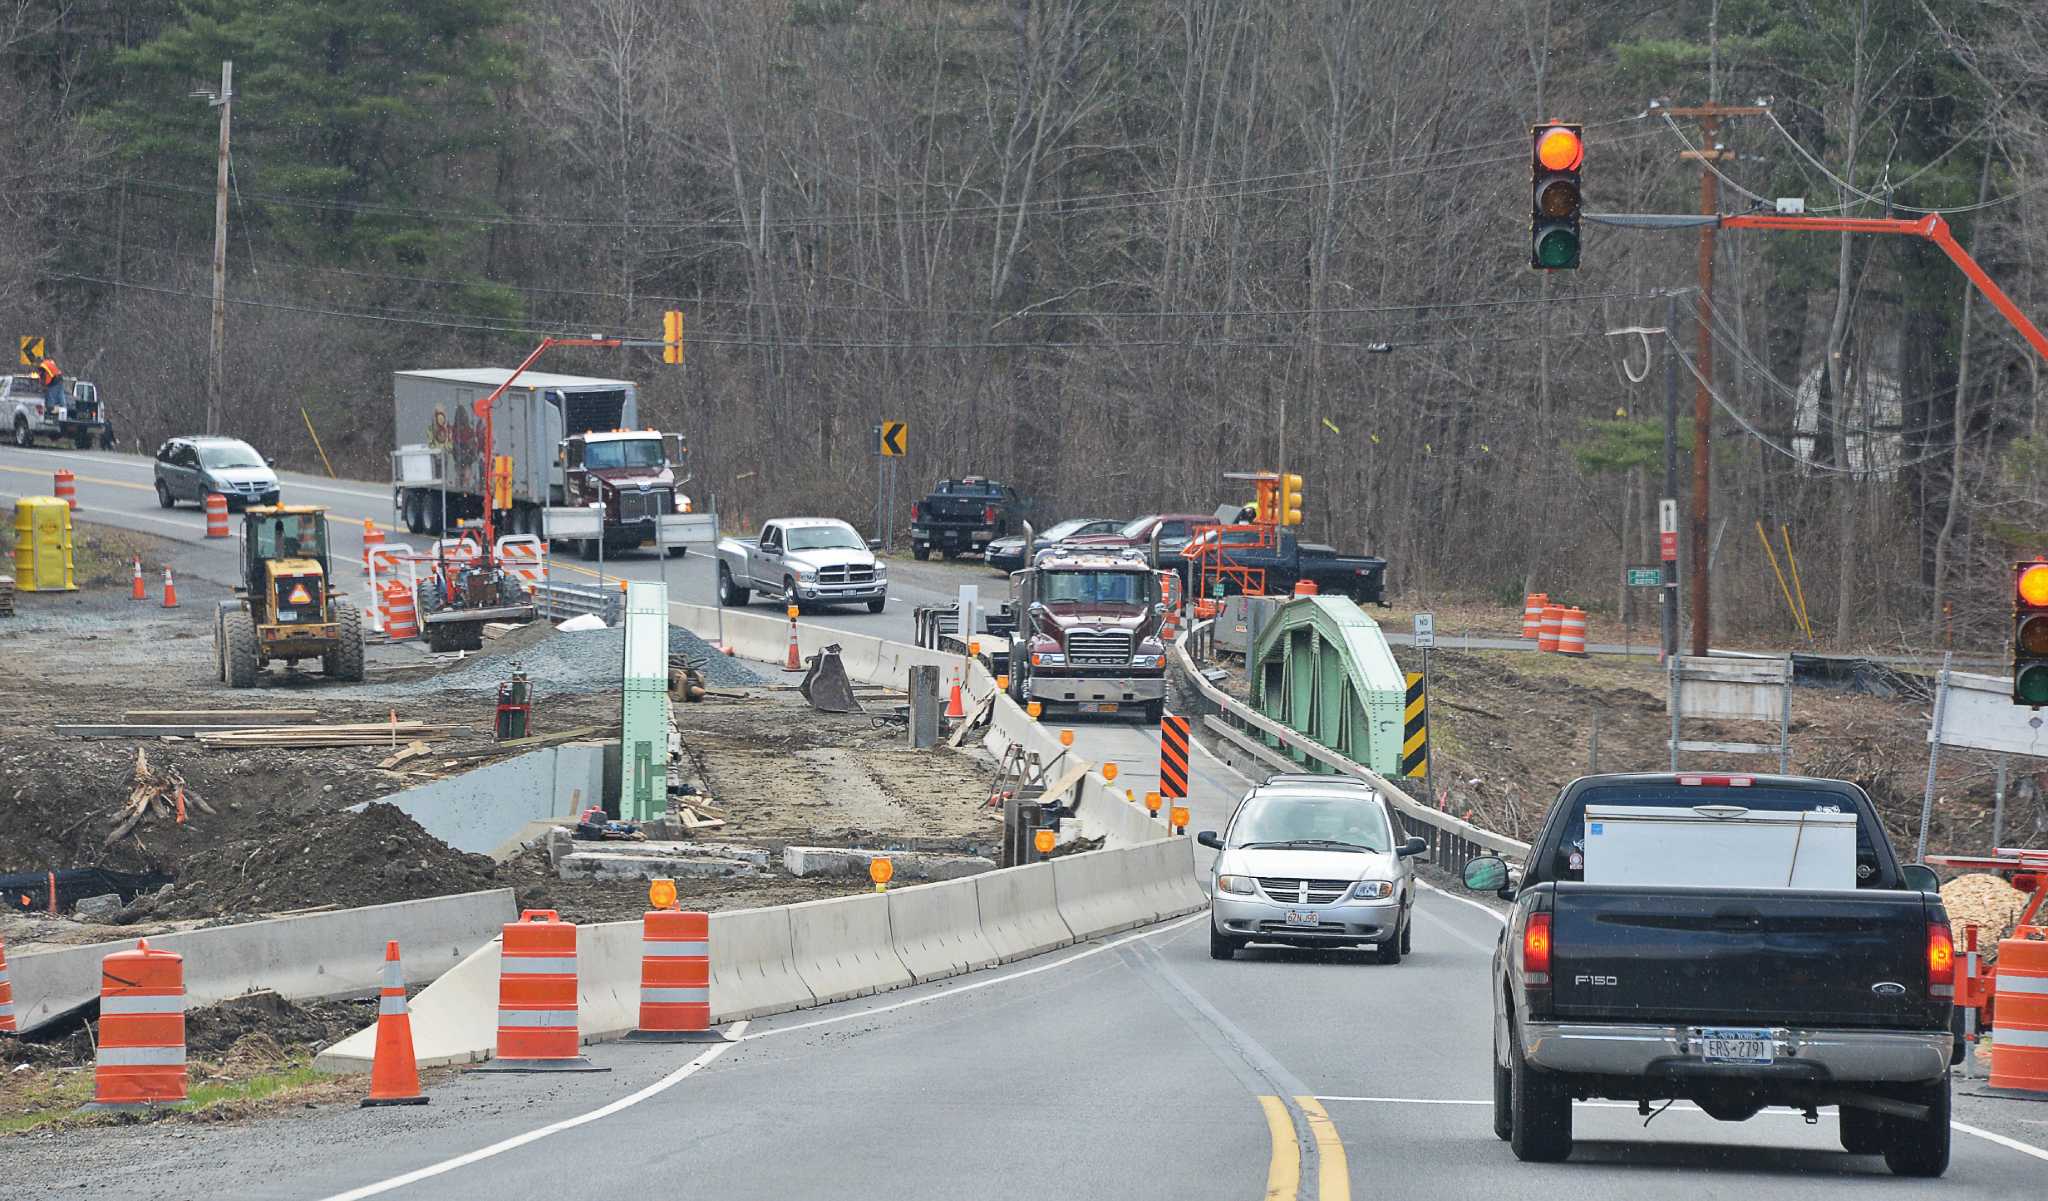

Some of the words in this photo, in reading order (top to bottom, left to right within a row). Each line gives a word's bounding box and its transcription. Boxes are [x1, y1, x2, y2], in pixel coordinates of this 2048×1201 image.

[1072, 657, 1126, 665] MACK
[1719, 1031, 1737, 1040] NEW
[1737, 1031, 1755, 1040] YORK
